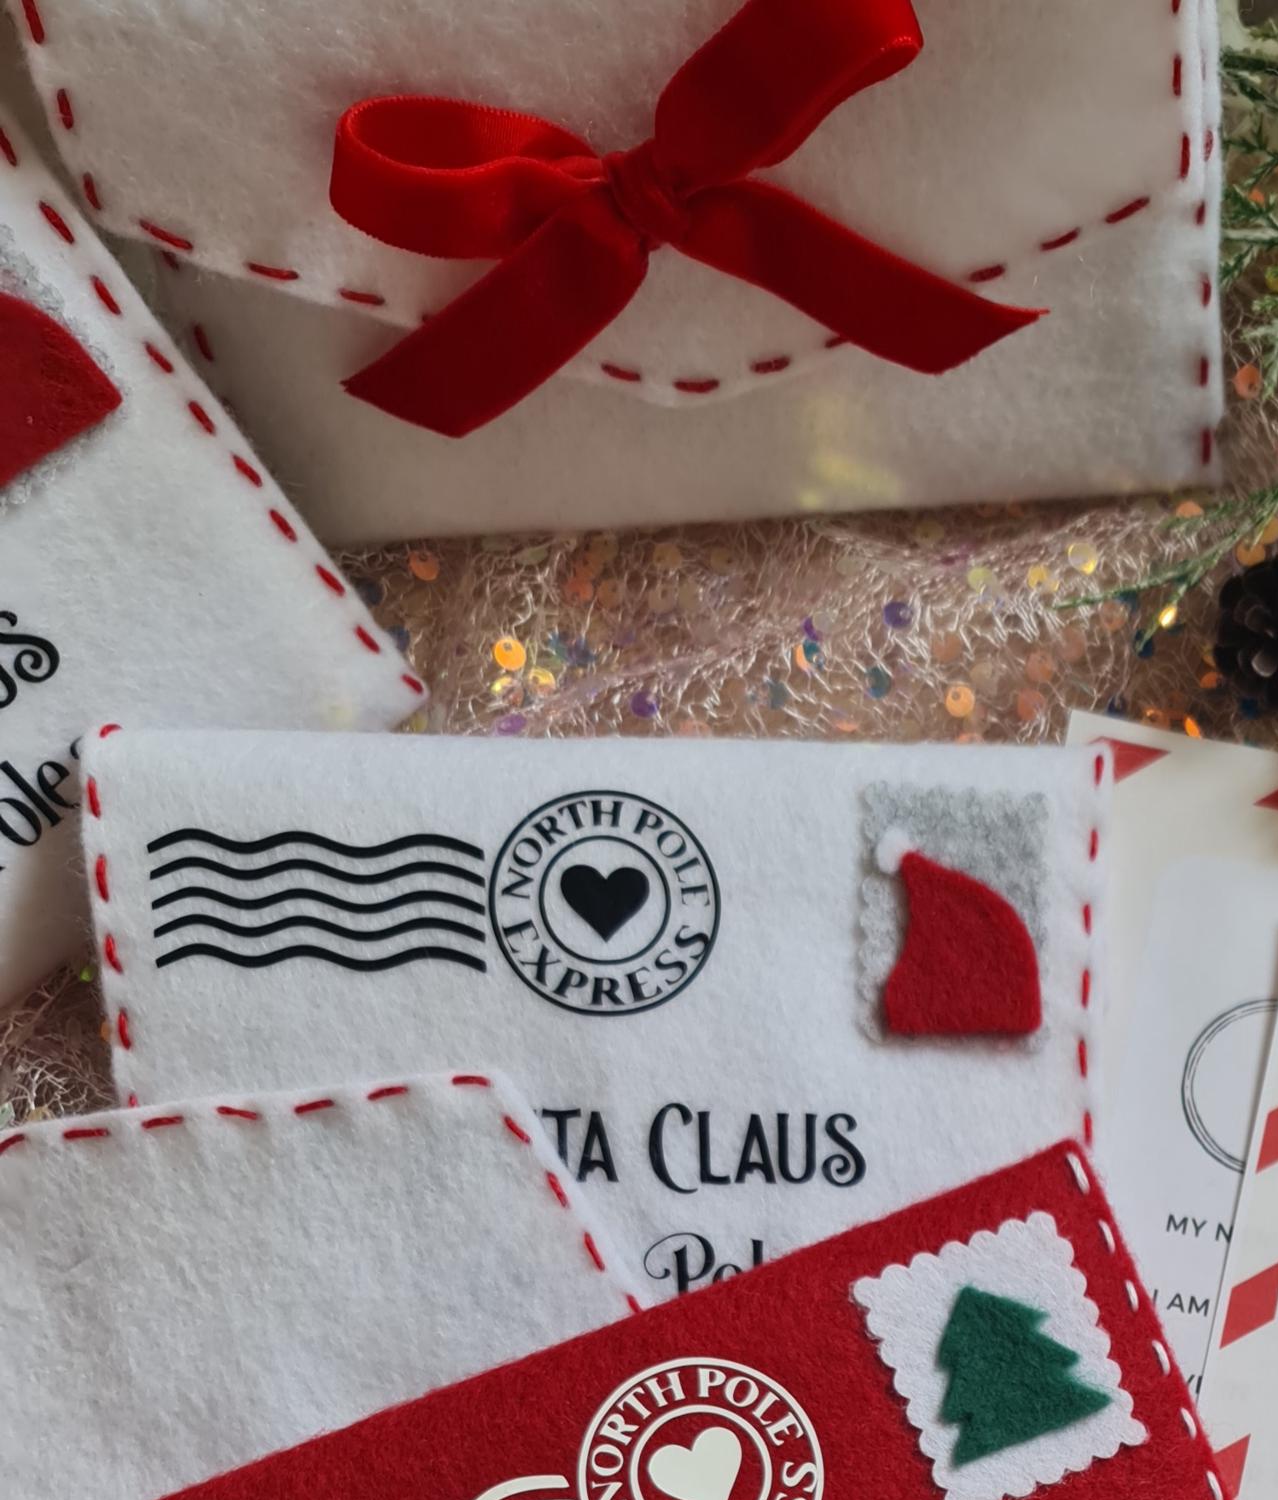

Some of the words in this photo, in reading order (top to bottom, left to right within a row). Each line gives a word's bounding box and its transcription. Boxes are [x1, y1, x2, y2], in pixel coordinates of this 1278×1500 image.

[0, 736, 82, 847] ole
[501, 799, 621, 900] NORTH
[633, 808, 711, 908] POLE
[501, 918, 709, 1006] EXPRESS
[541, 1107, 619, 1183] TA
[647, 1102, 867, 1194] CLAUS
[1166, 1214, 1207, 1237] MY
[1167, 1293, 1210, 1317] AM
[697, 1368, 806, 1446] POLE
